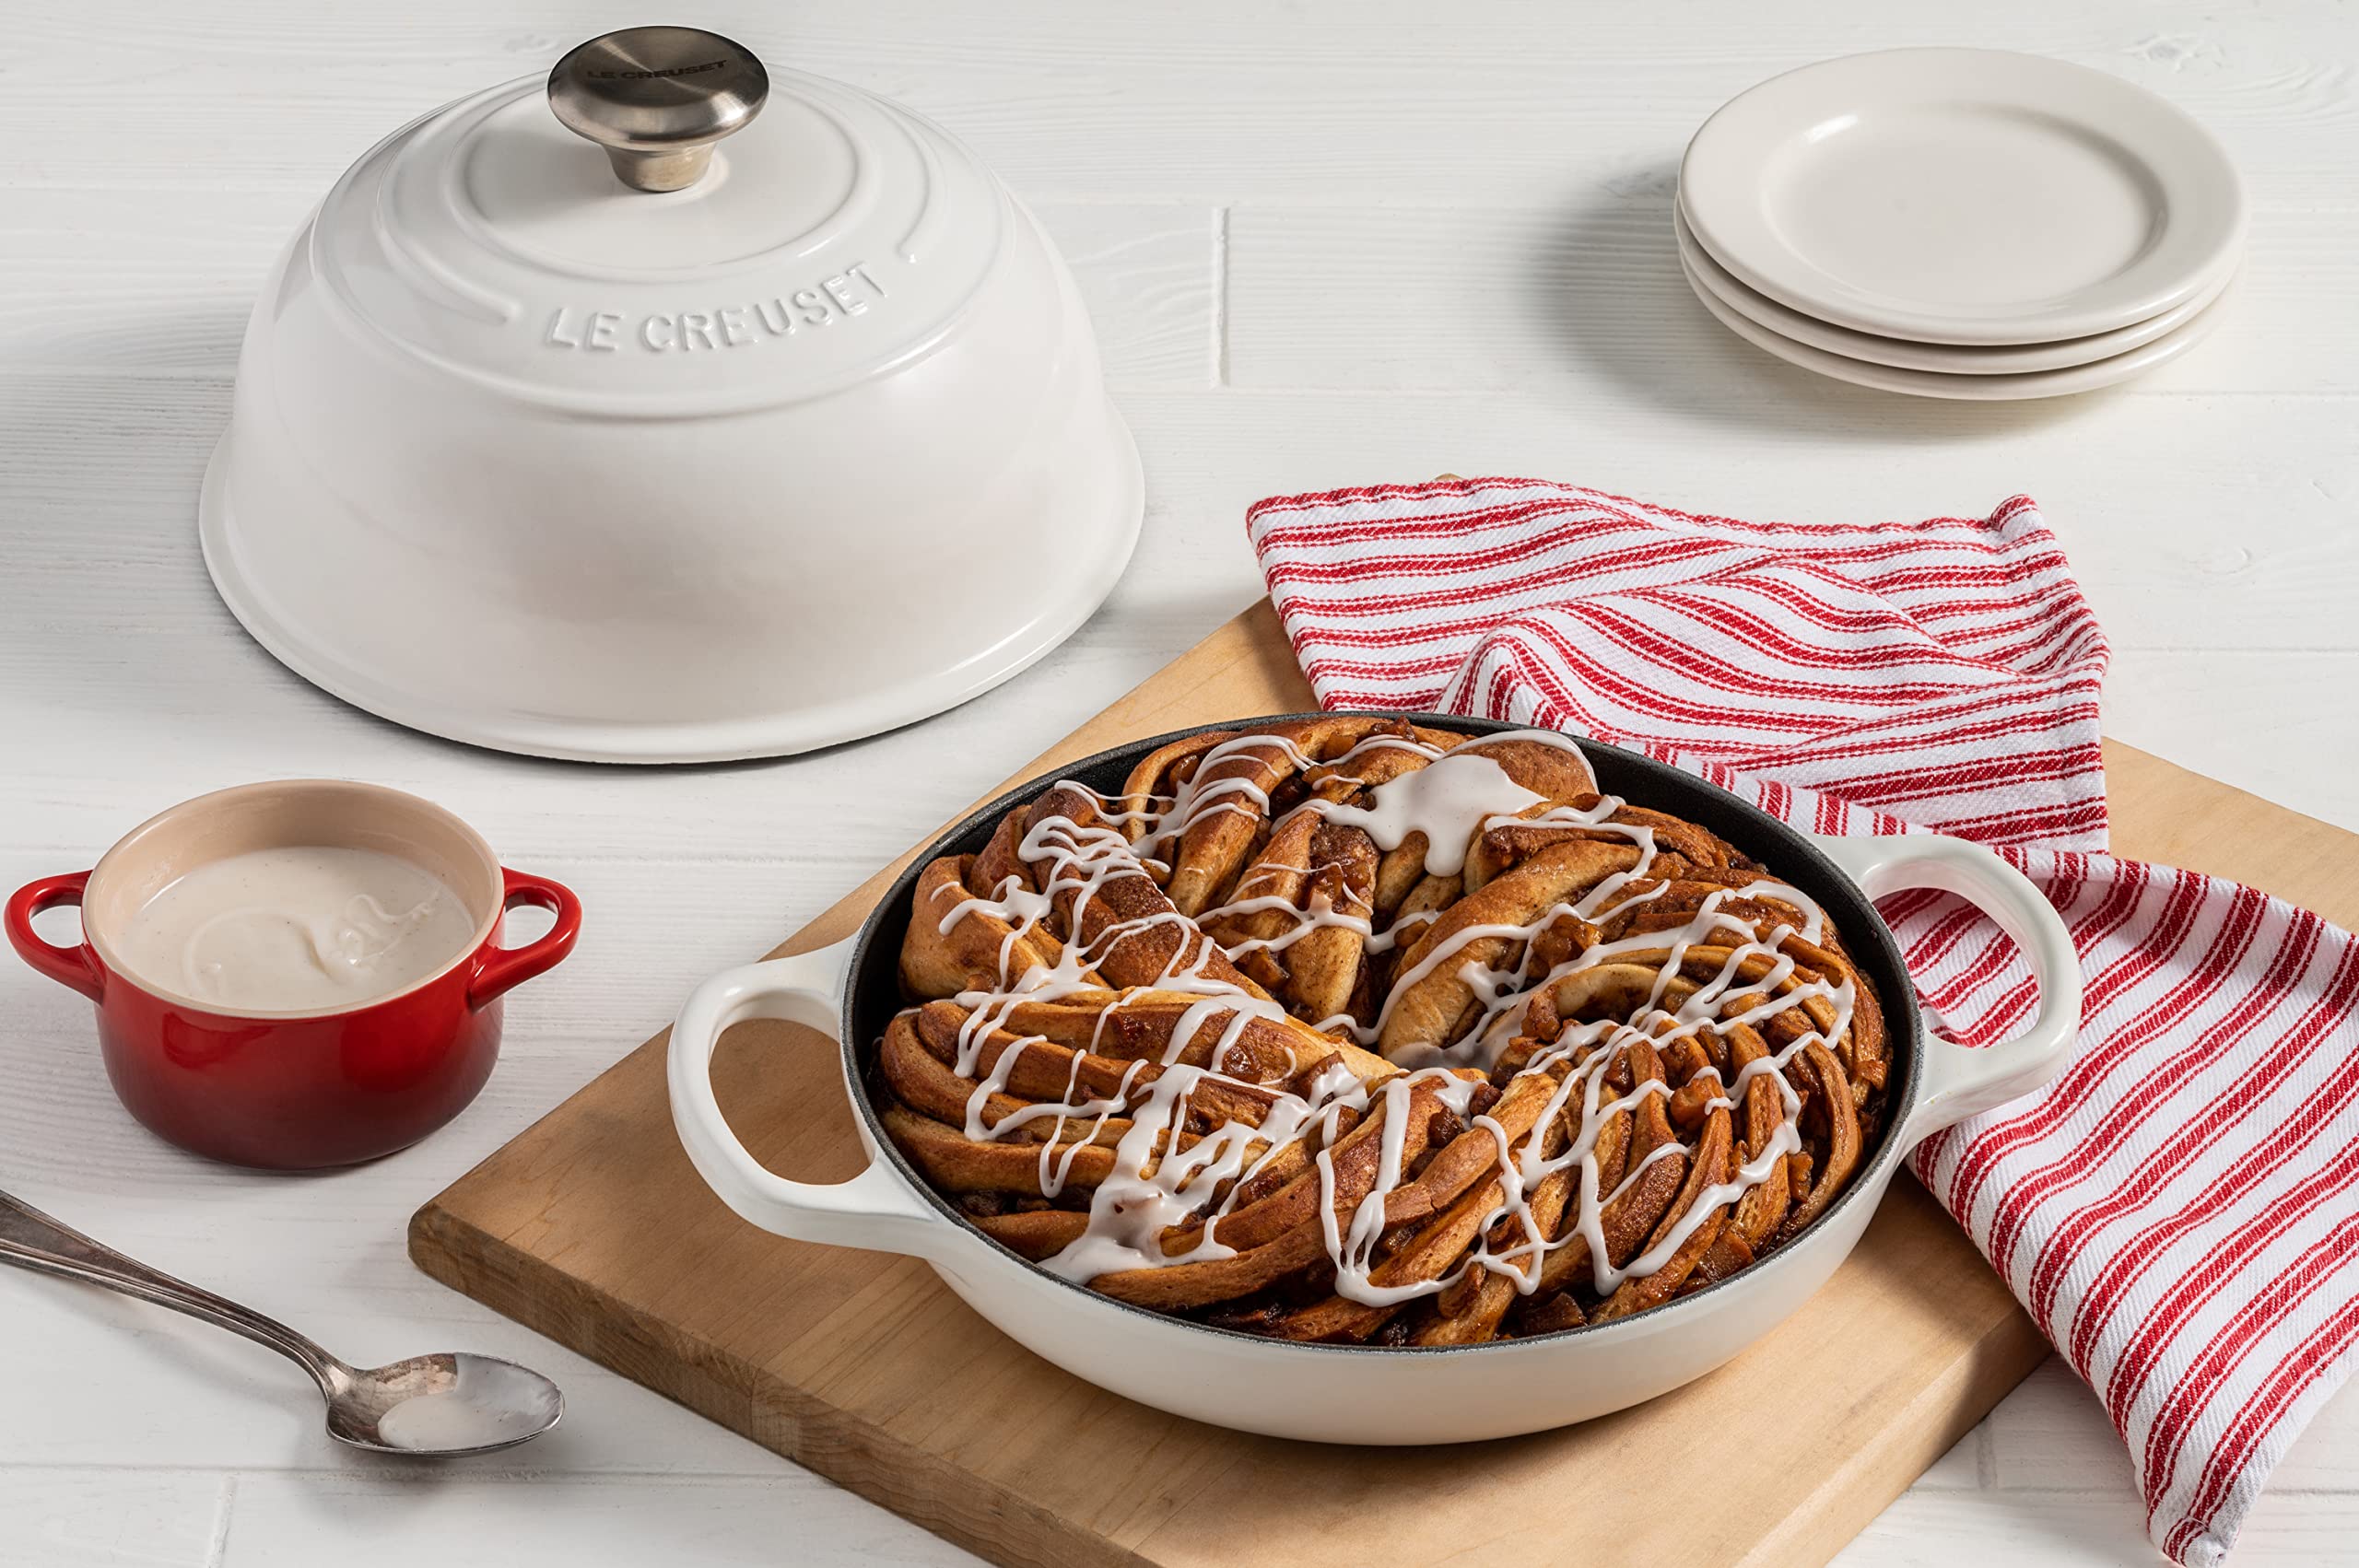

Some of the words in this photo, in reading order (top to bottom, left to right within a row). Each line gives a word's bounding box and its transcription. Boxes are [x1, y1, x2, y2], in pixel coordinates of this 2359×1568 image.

[588, 70, 616, 78] LE
[620, 60, 727, 78] CREUSET
[546, 308, 623, 352] LE
[641, 263, 888, 352] CREUSET
